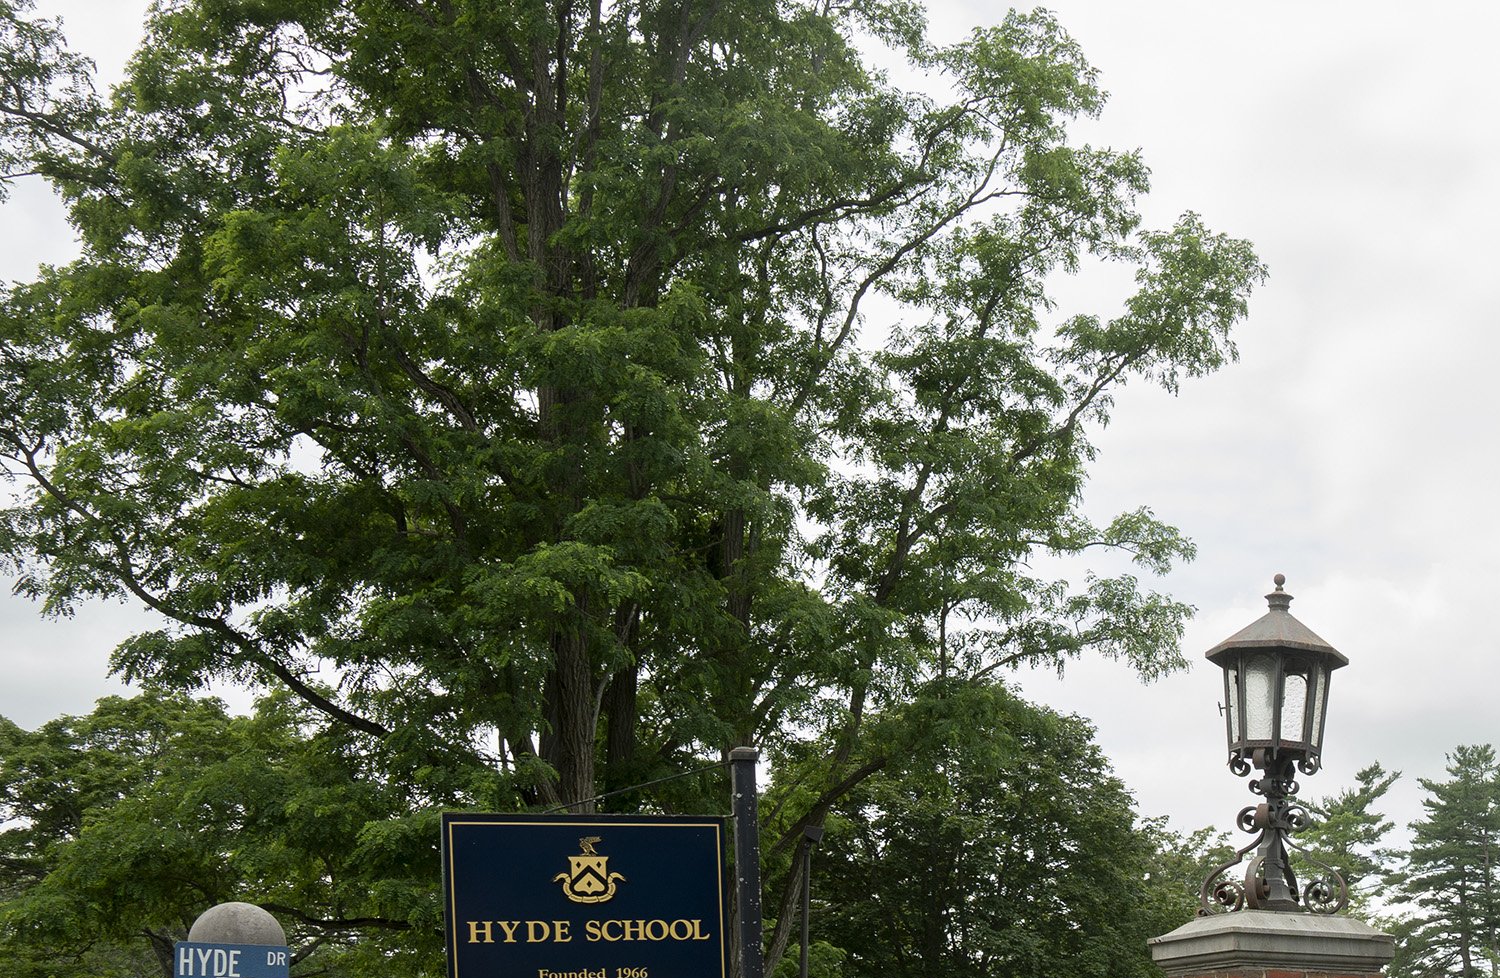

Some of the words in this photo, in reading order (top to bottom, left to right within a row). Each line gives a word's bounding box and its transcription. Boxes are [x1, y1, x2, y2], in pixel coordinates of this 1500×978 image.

[466, 920, 573, 944] HYDE
[585, 918, 711, 943] SCHOOL
[179, 947, 242, 978] HYDE
[266, 951, 286, 966] DR
